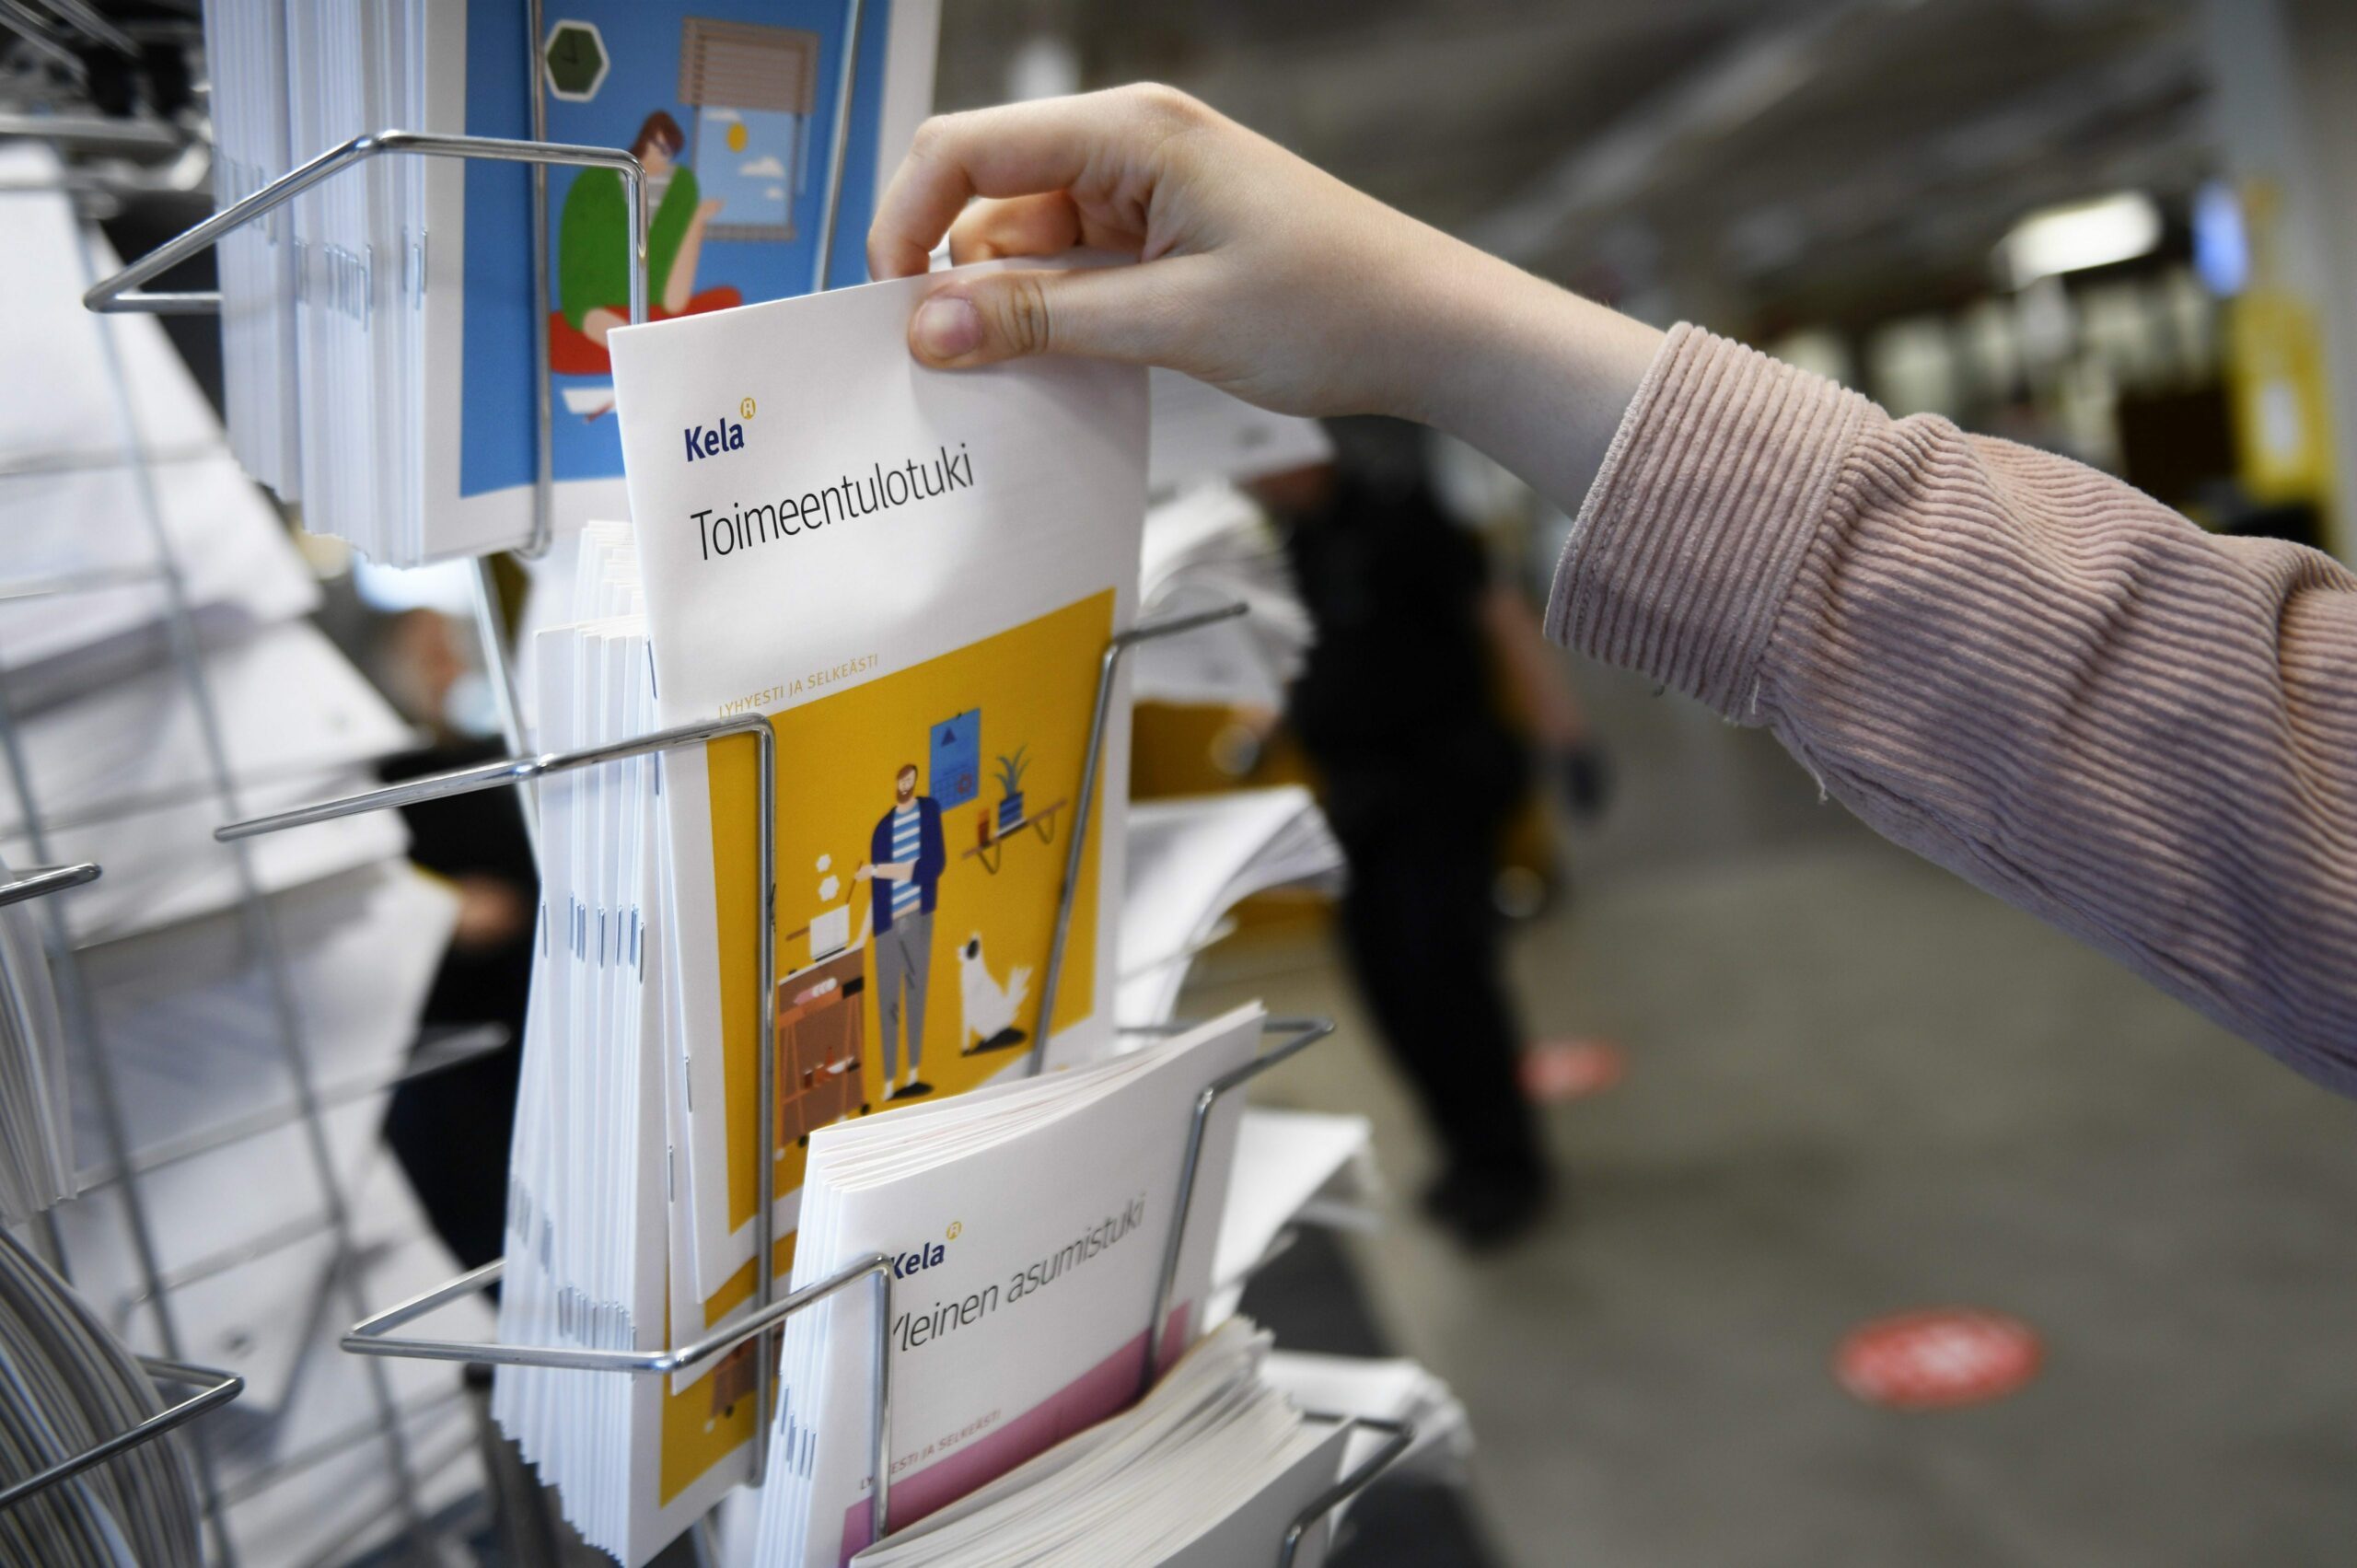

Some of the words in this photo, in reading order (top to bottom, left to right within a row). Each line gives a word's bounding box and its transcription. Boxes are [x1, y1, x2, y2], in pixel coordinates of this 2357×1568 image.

[684, 417, 744, 462] Kela
[690, 443, 975, 561] Toimeentulotuki
[789, 679, 803, 697] JA
[807, 653, 878, 690] SELKEÄSTI
[1007, 1191, 1146, 1304] asumistuki
